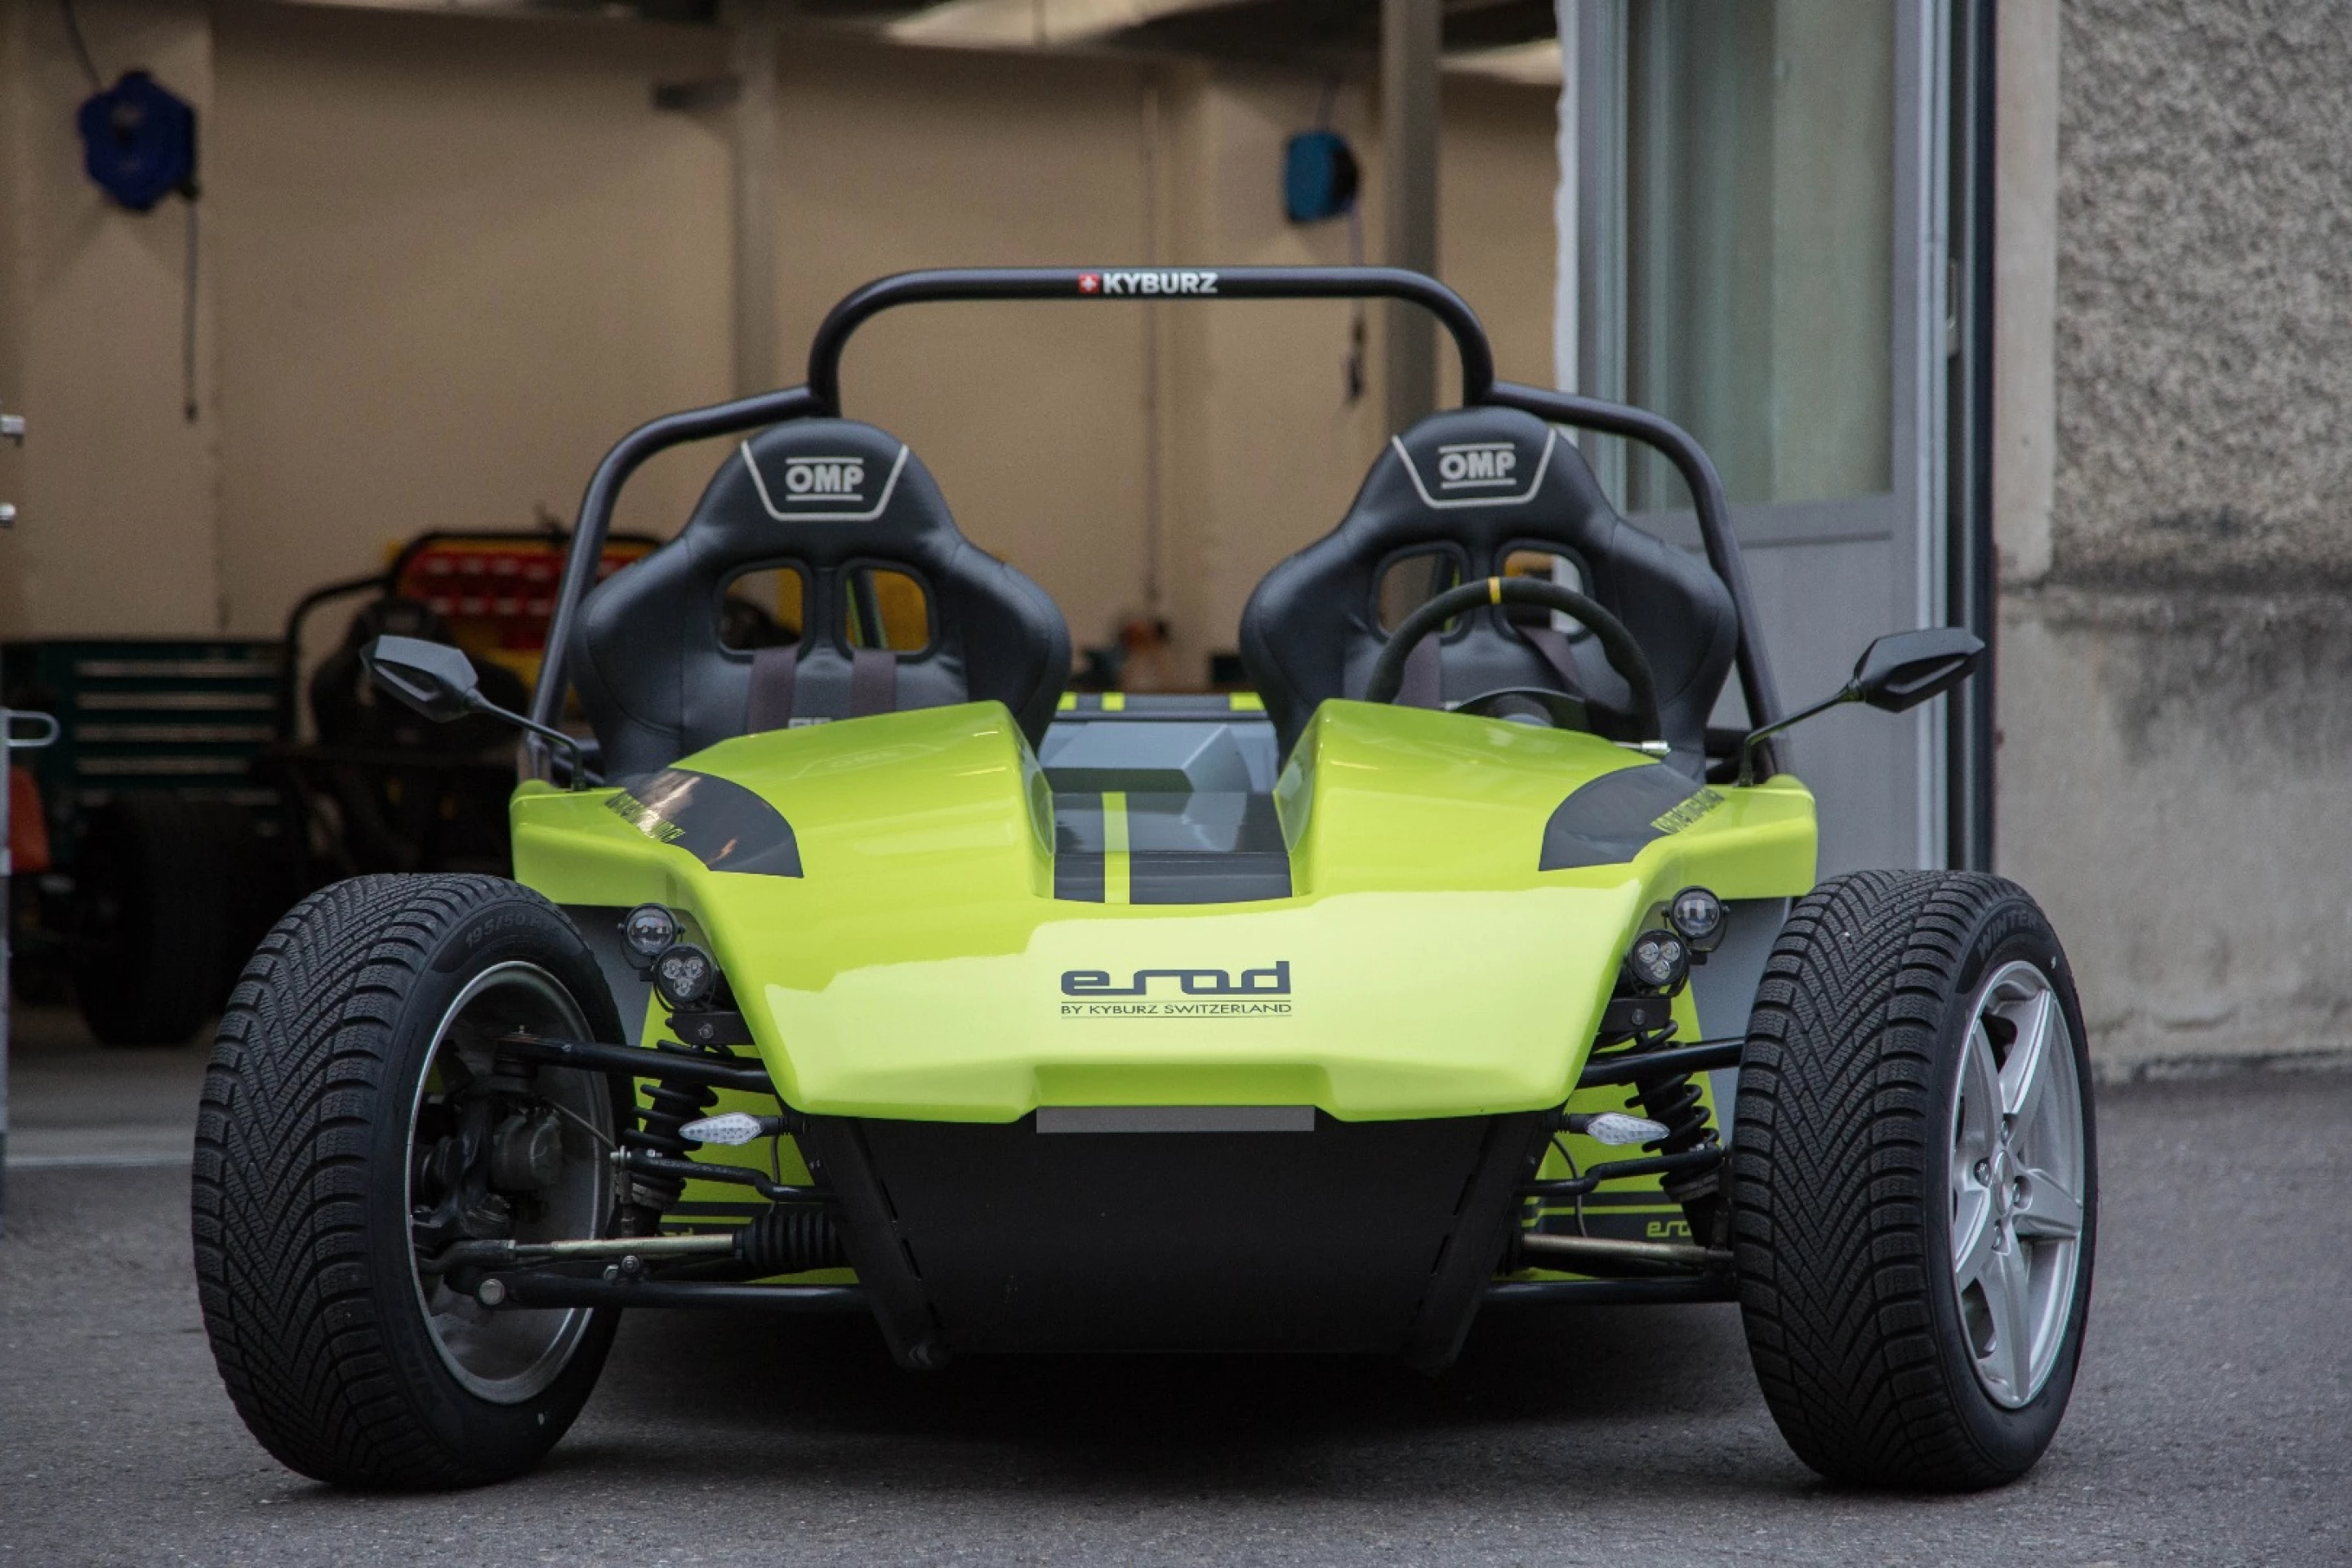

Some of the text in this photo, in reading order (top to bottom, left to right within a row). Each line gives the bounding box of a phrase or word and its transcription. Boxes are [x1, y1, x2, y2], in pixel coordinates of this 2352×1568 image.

[1103, 272, 1218, 294] KYBURZ
[1439, 449, 1517, 480] OMP
[785, 464, 864, 493] OMP
[1061, 1004, 1292, 1015] BY KYBURZ SWITZERLAND
